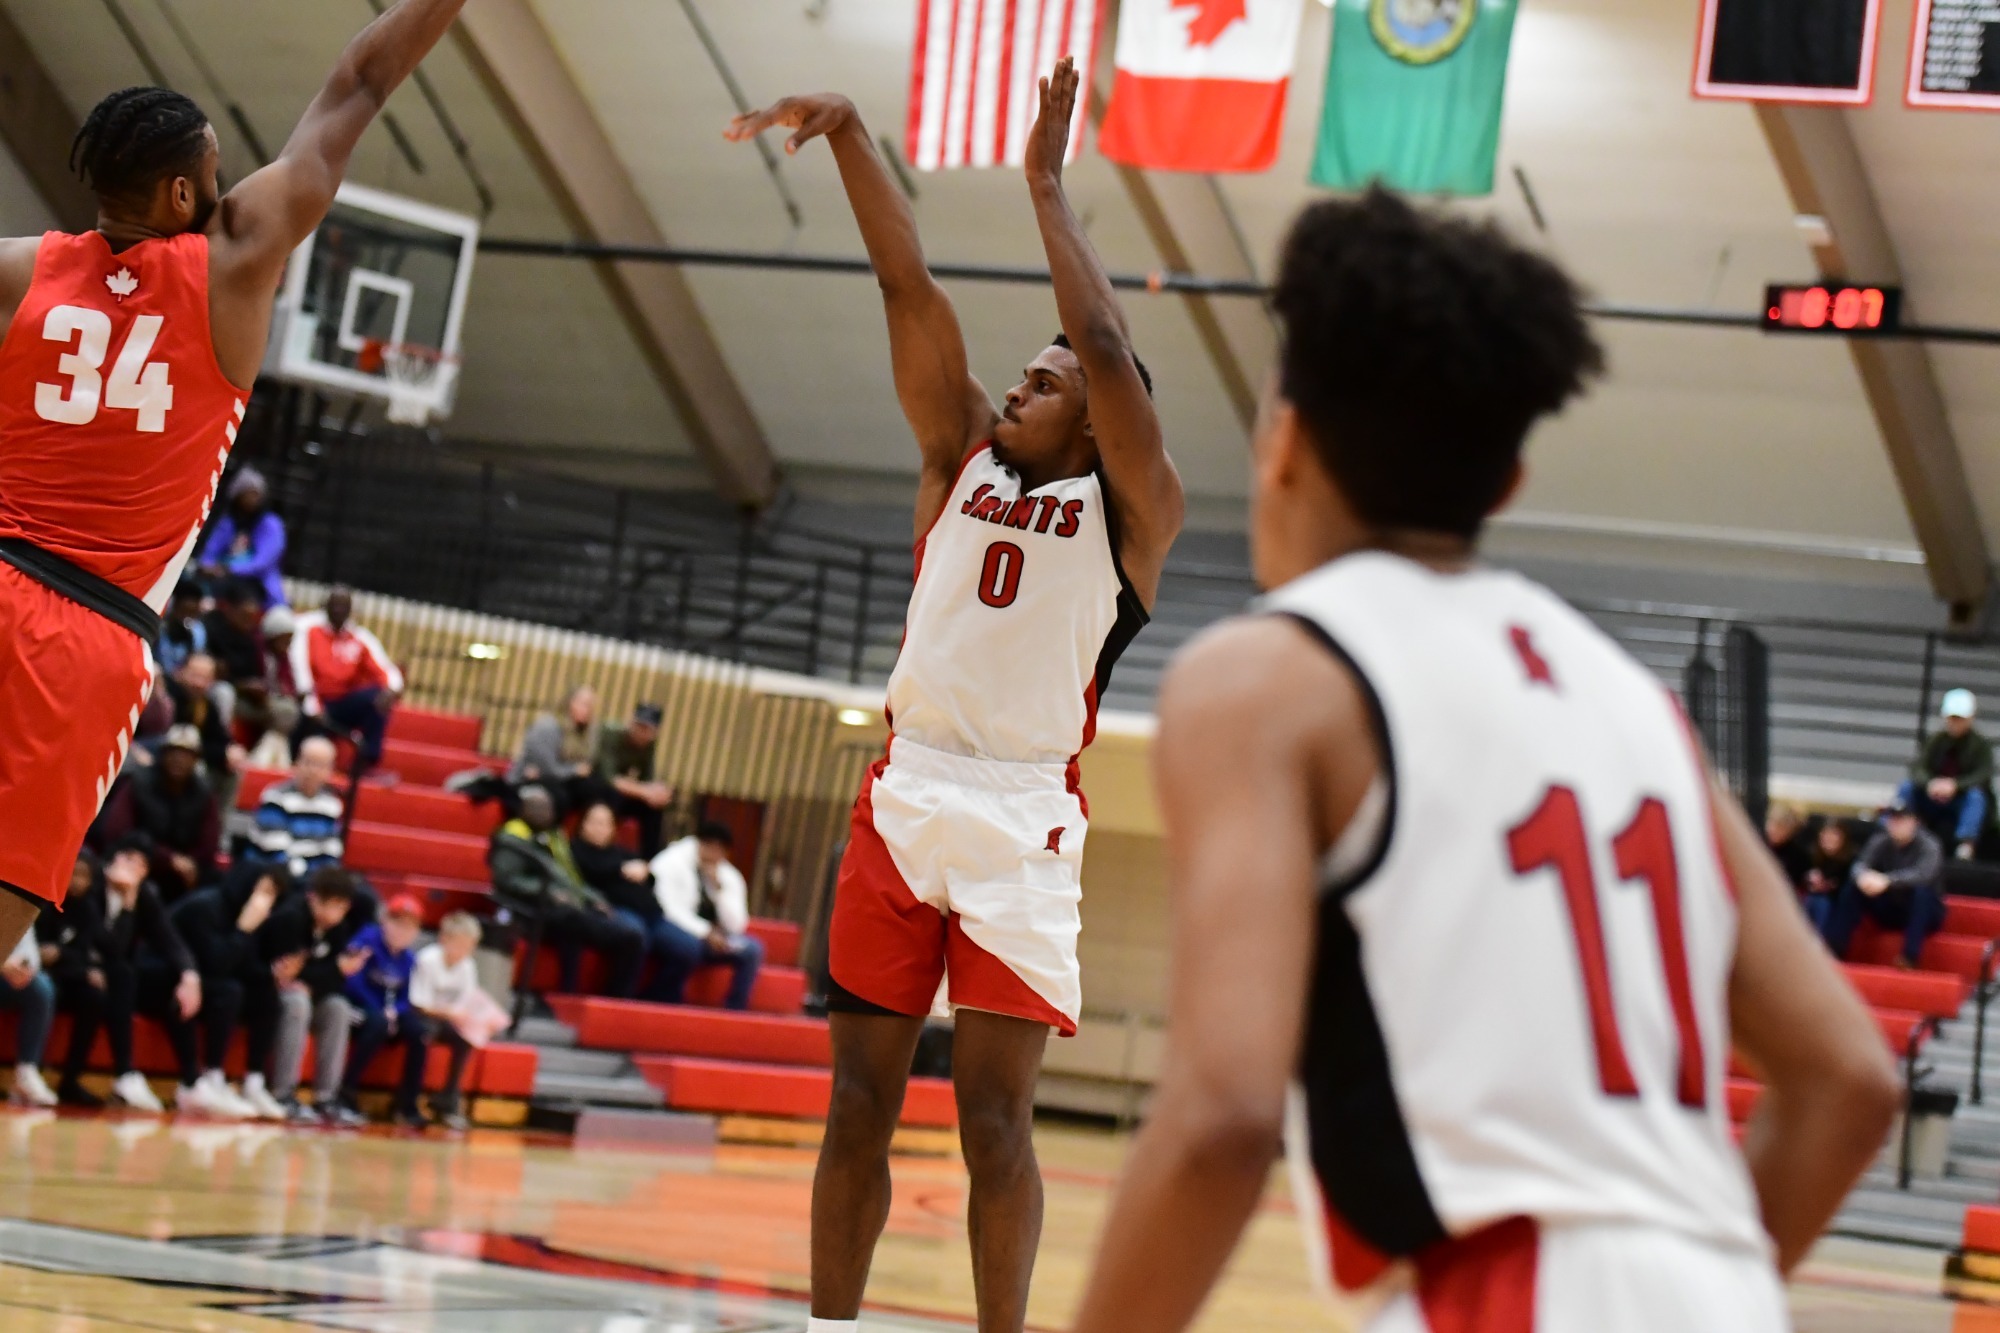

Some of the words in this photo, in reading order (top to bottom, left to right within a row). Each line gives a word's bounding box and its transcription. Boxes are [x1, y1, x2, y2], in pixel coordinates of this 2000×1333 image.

[34, 304, 174, 432] 34
[978, 541, 1024, 608] 0
[1506, 784, 1706, 1109] 11
